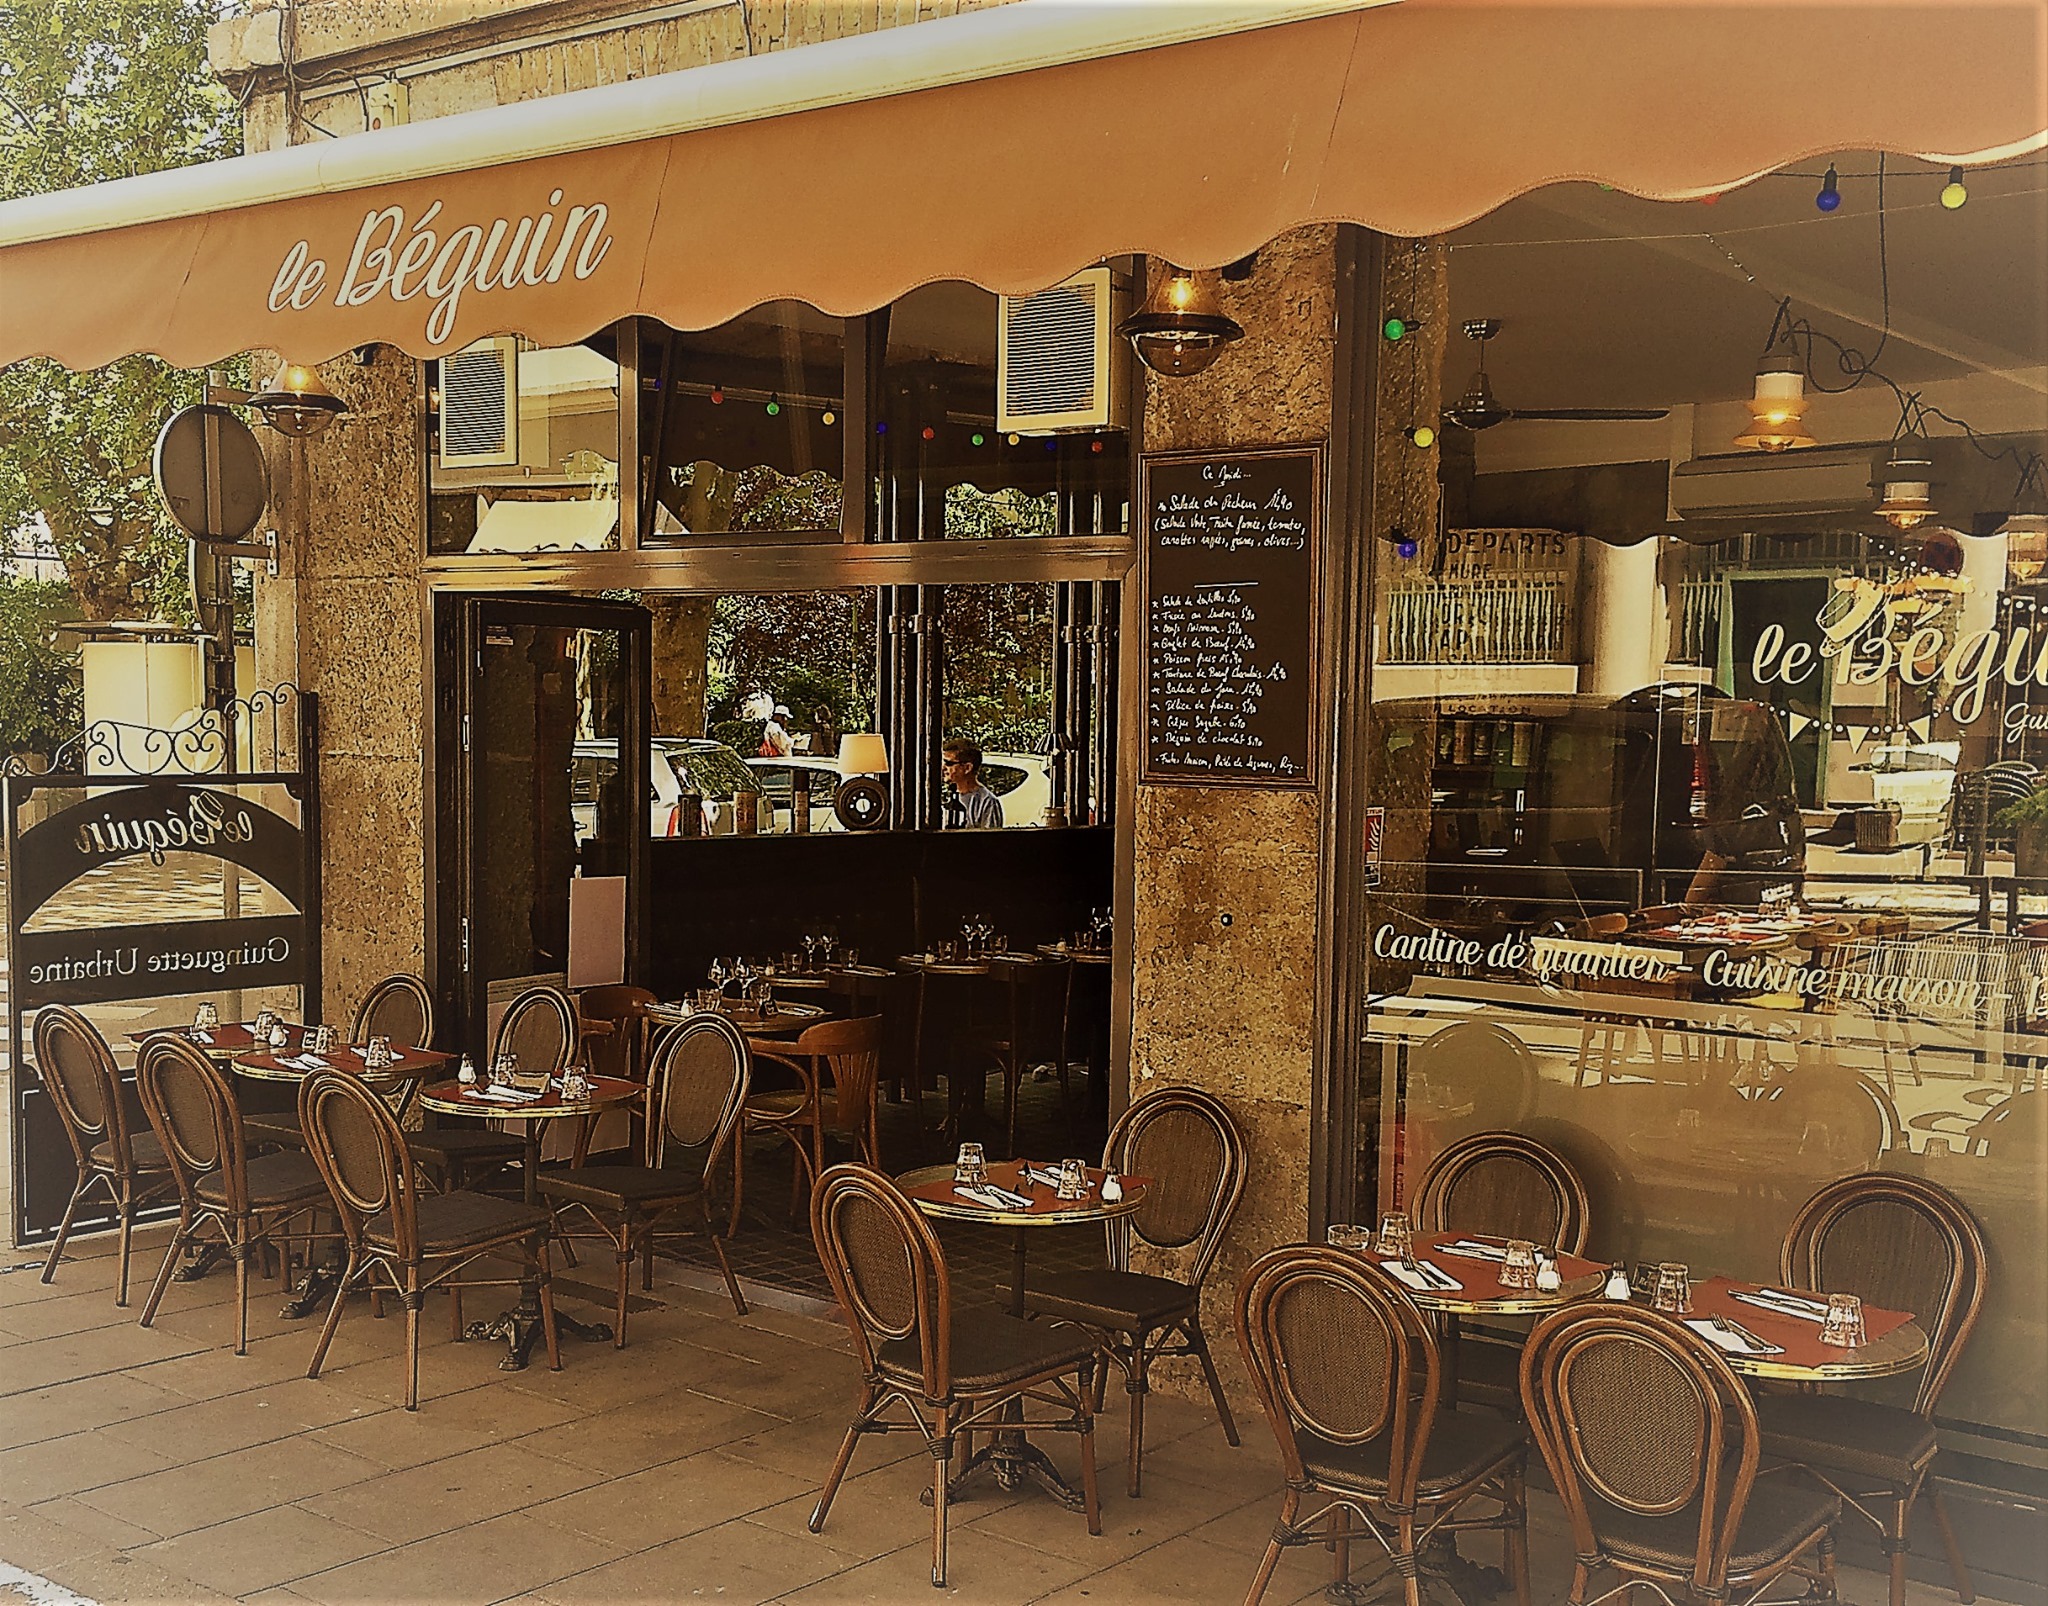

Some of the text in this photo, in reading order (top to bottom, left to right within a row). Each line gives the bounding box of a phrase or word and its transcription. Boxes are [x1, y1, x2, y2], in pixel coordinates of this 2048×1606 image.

[268, 188, 614, 345] le Béguin
[1170, 494, 1200, 510] Salade
[1449, 532, 1566, 555] DEPARTS
[1752, 624, 1817, 685] le
[1165, 682, 1197, 695] Salade
[1374, 923, 1484, 966] Cantine
[1531, 941, 1673, 983] quartier
[1703, 948, 1829, 995] Cuisine
[1836, 969, 1990, 1010] maison
